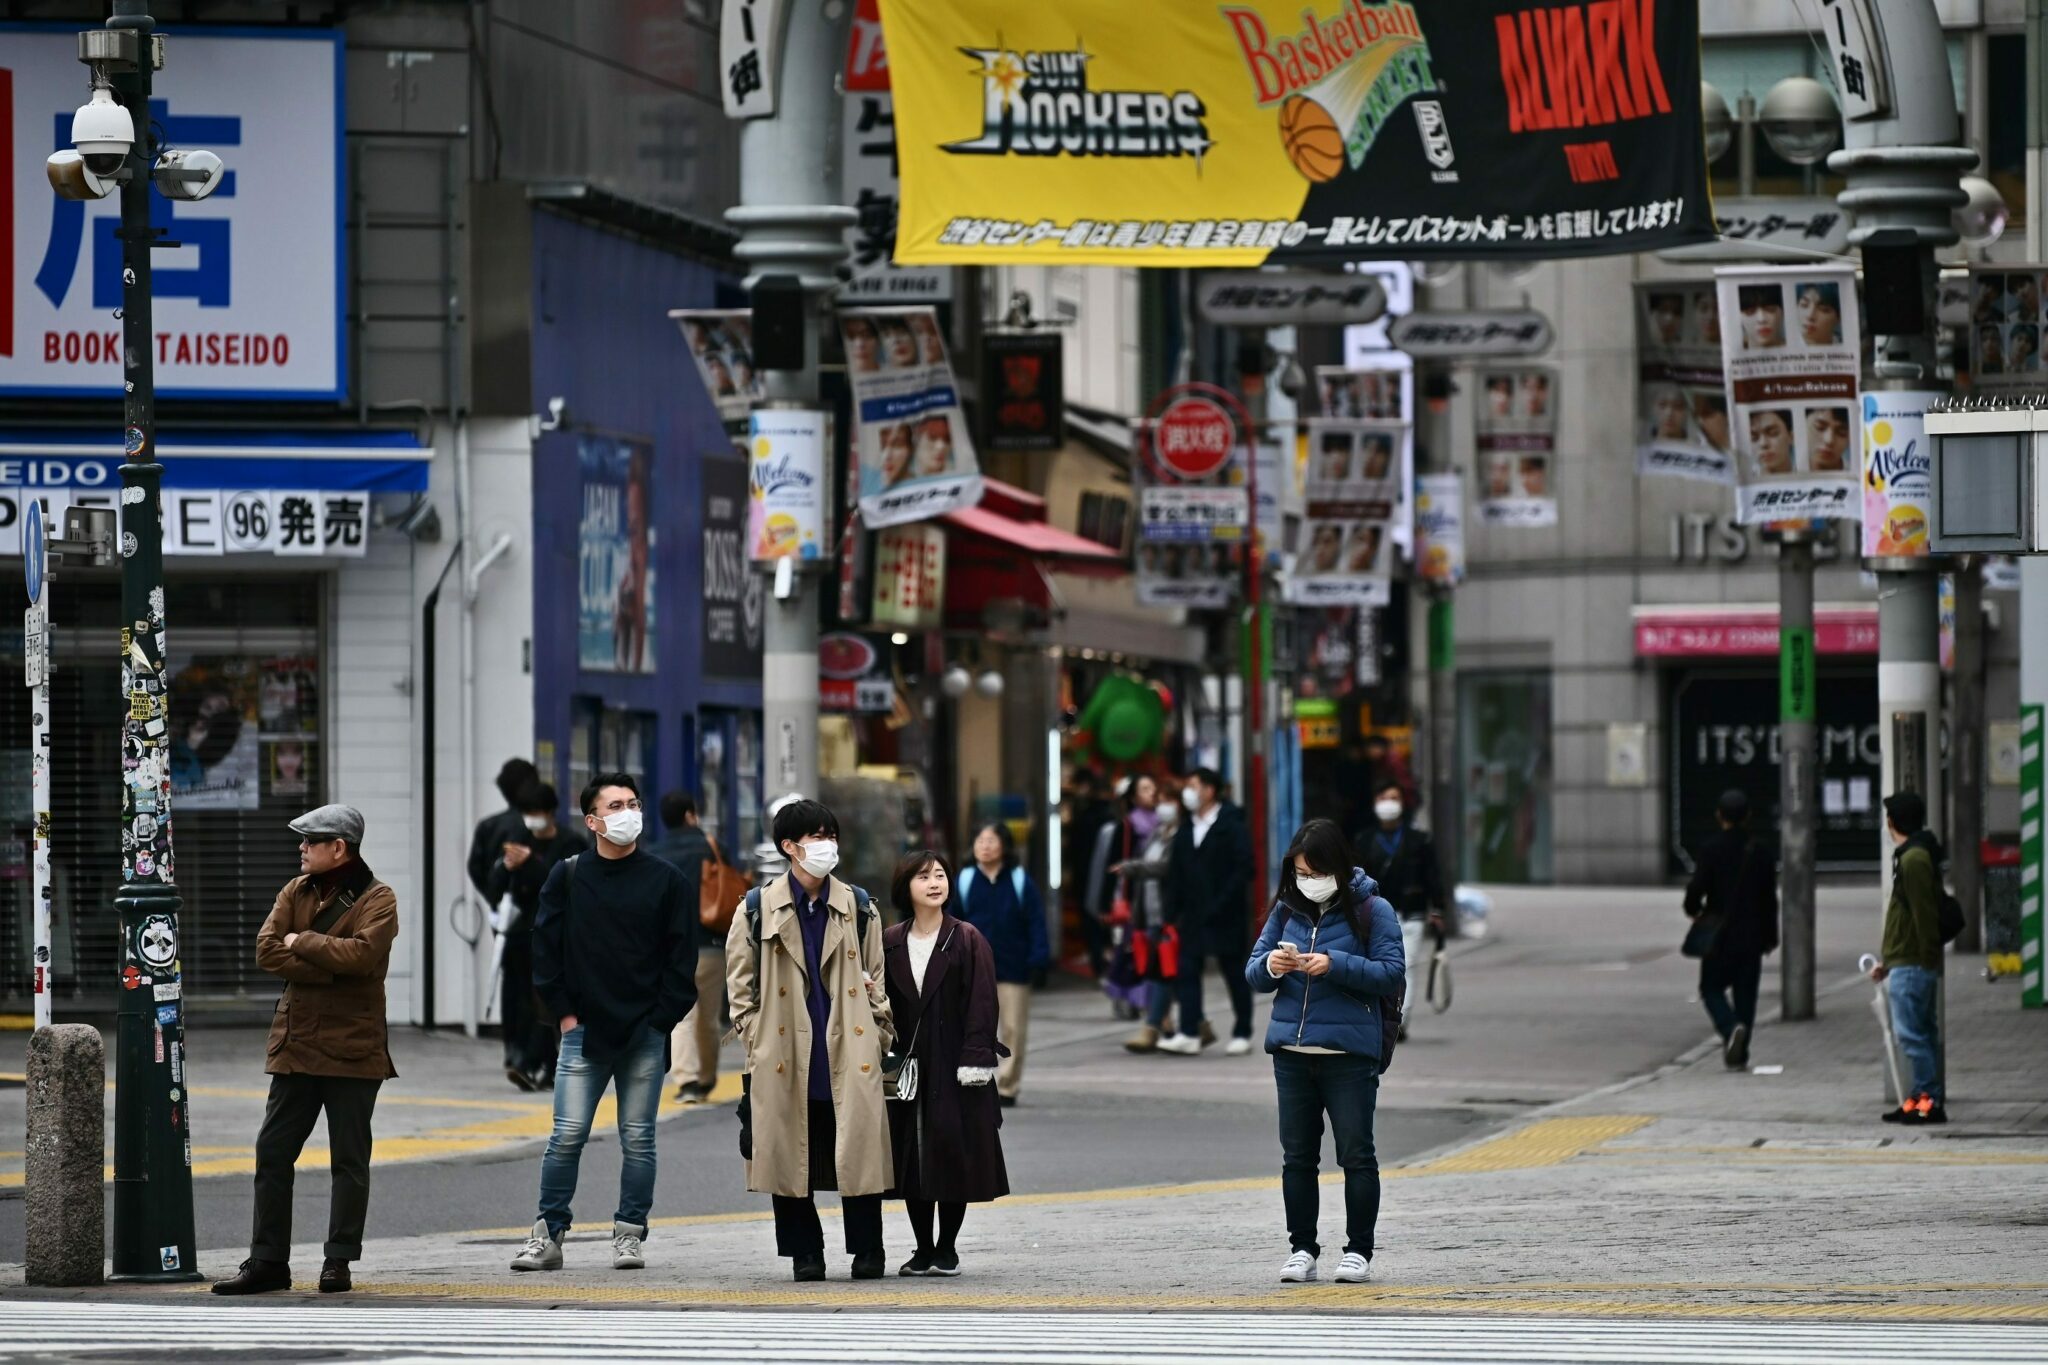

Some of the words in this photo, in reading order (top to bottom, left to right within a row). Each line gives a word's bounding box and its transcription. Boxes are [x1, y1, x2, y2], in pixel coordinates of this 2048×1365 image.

[728, 0, 760, 103] ー街
[939, 48, 1214, 156] ROCKERS
[1024, 51, 1086, 88] SUN
[1225, 0, 1424, 103] Basketball
[34, 99, 241, 310] 店
[44, 331, 119, 364] BOOK
[157, 333, 289, 366] TAISEIDO
[0, 461, 107, 484] EIDO
